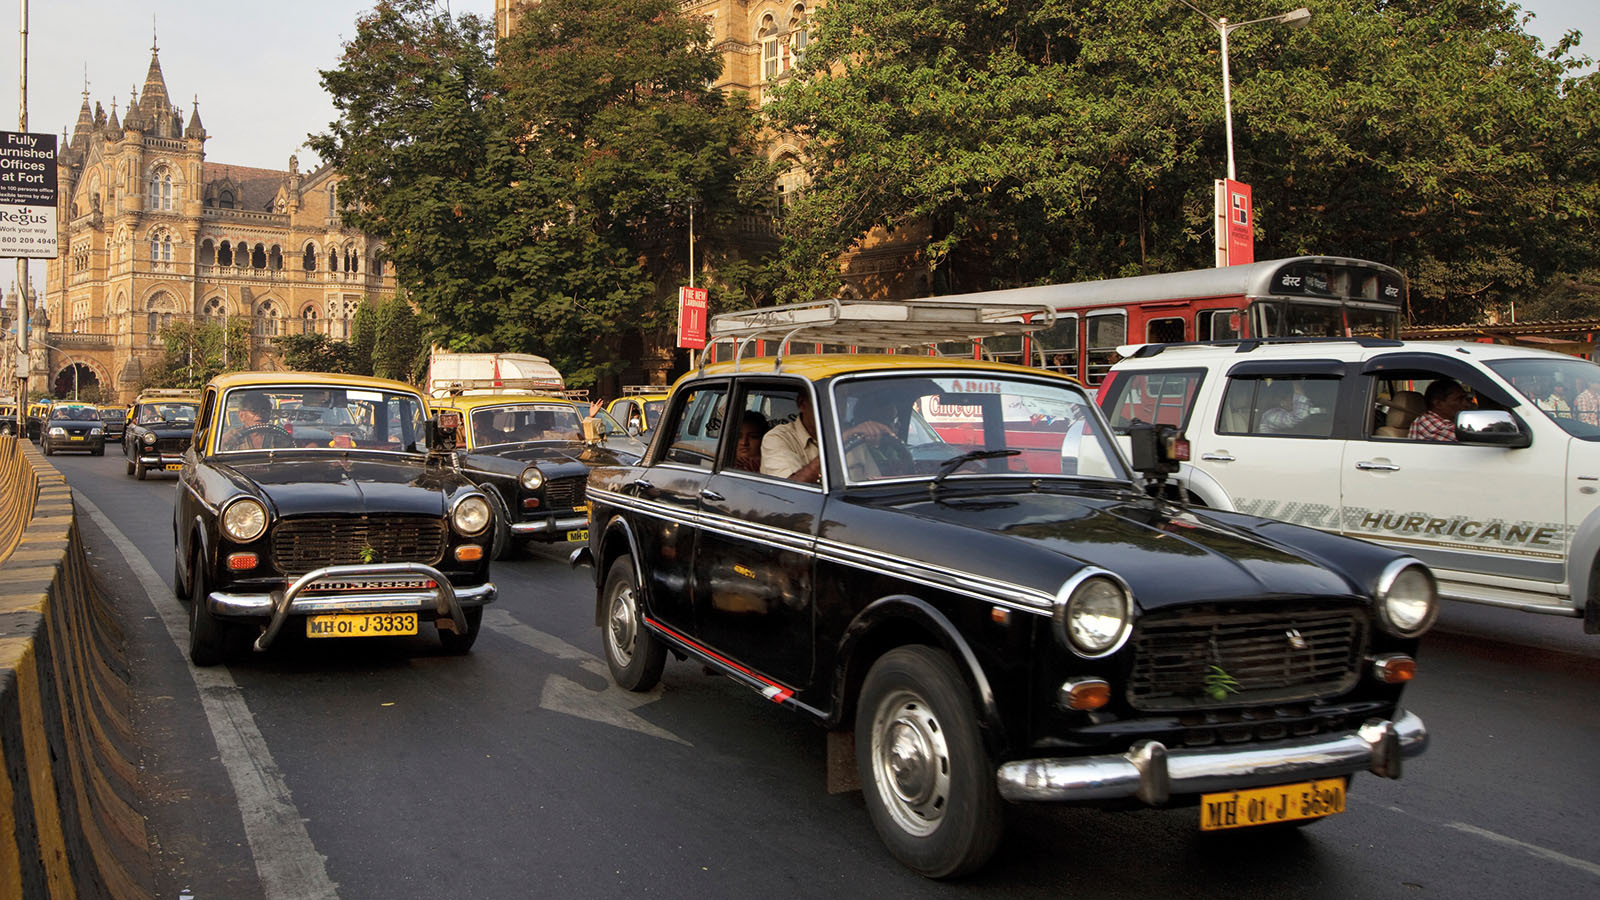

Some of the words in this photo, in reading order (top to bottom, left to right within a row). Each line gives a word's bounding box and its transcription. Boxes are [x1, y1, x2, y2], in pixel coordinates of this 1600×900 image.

[8, 134, 37, 148] Fully
[0, 158, 46, 171] Offices
[1, 172, 15, 182] at
[18, 172, 44, 183] Fort
[0, 207, 47, 226] Regus
[1360, 512, 1558, 545] HURRICANE
[1206, 800, 1238, 828] MH
